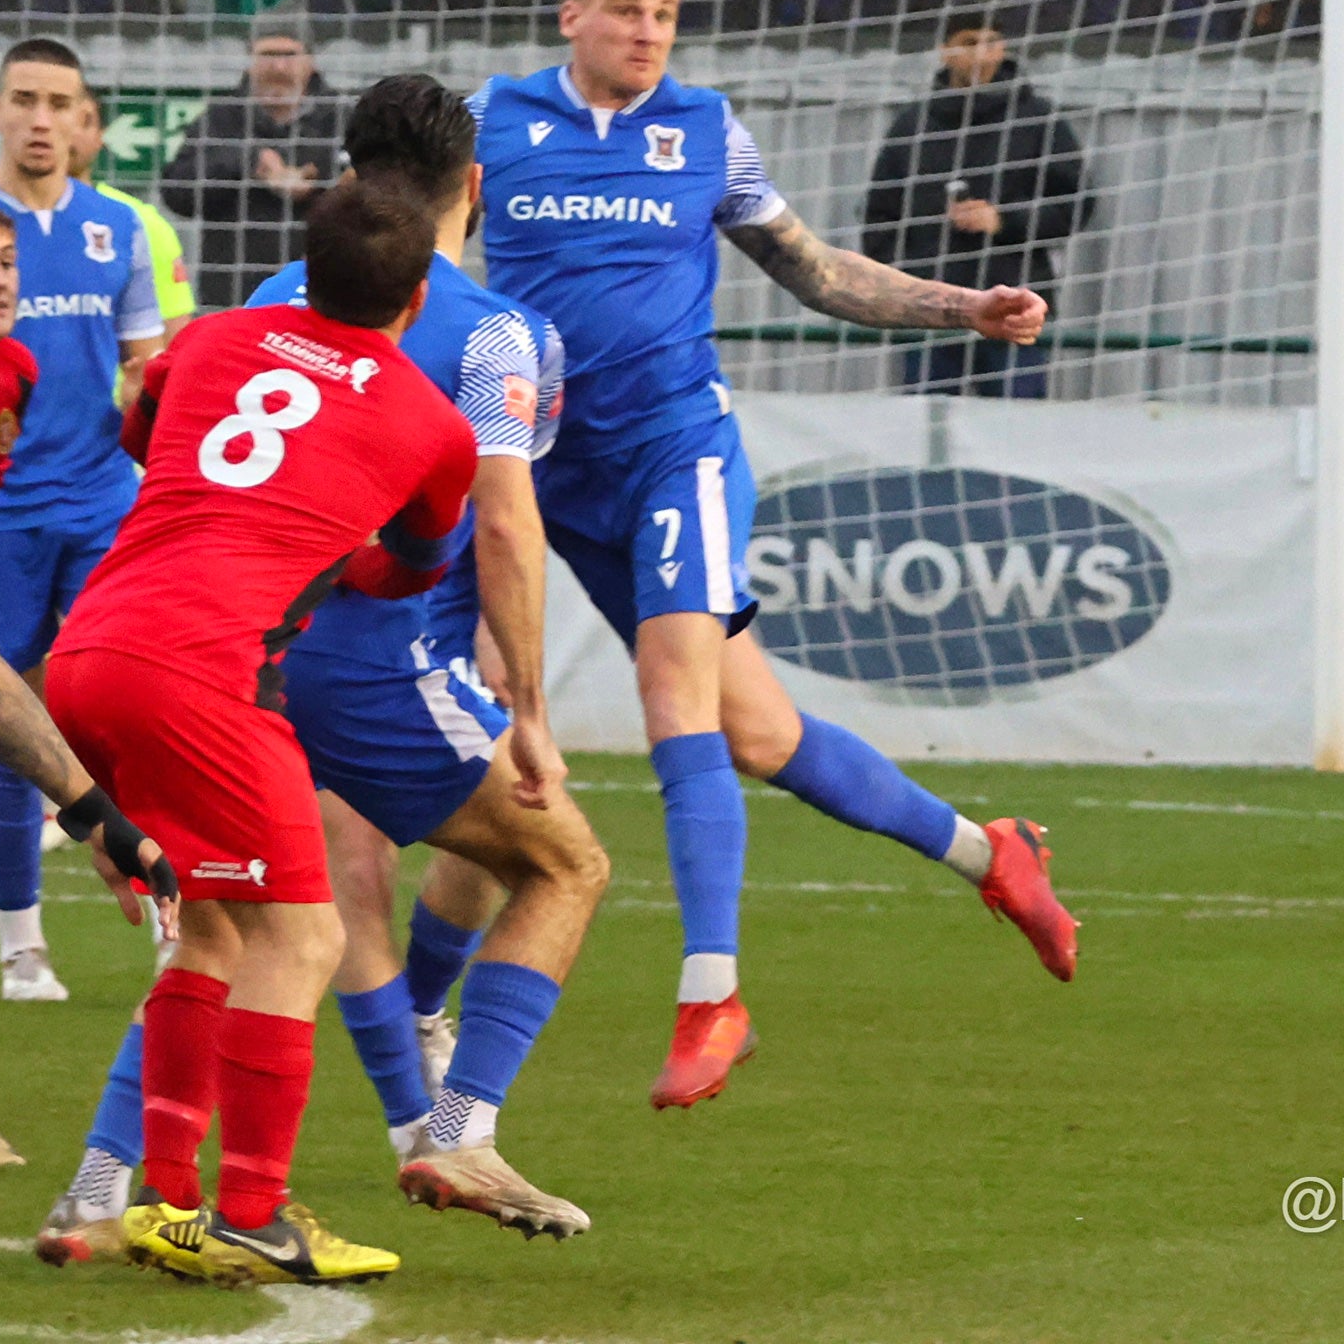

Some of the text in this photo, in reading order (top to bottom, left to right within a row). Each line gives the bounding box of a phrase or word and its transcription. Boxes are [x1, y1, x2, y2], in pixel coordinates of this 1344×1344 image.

[15, 294, 112, 320] ARMIN
[199, 368, 321, 488] 8
[653, 508, 682, 559] 7
[745, 536, 1134, 621] SNOWS
